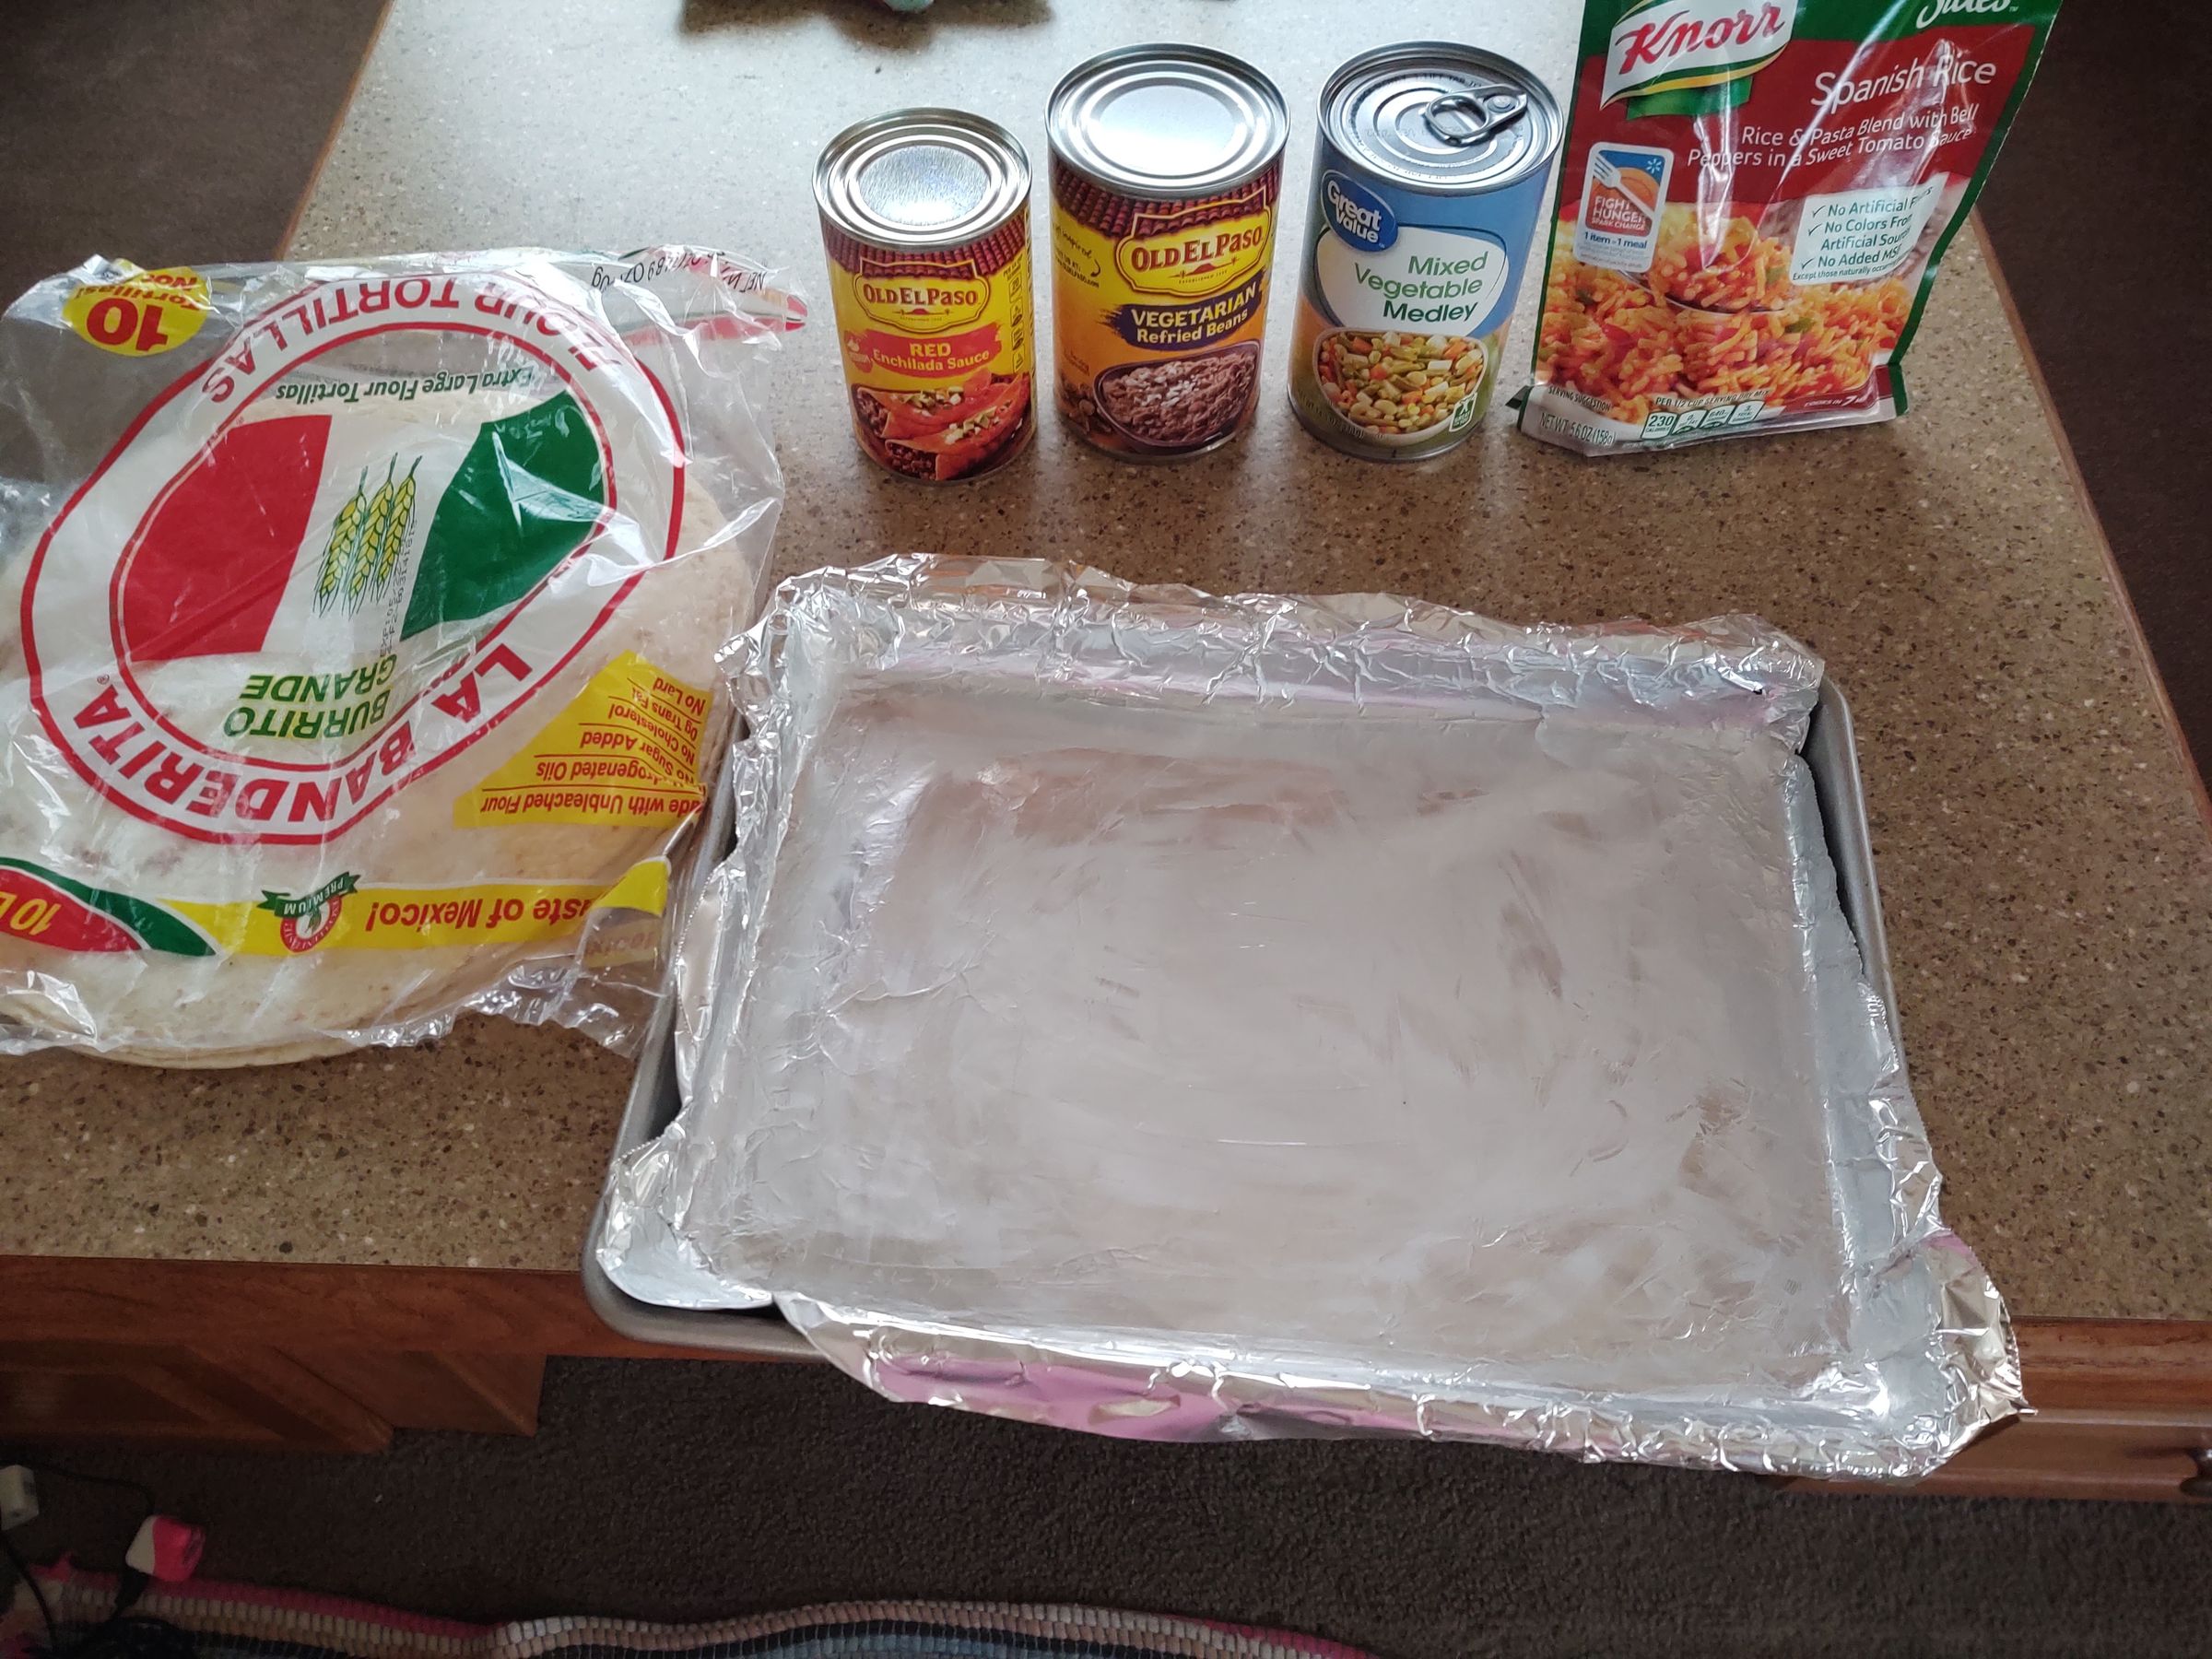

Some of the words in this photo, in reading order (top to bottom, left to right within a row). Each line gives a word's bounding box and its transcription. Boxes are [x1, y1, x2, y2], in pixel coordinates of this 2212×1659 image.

[1615, 2, 1785, 76] Knorr
[1810, 57, 1924, 114] Spanish
[1933, 52, 1996, 88] Rice
[1742, 125, 1783, 147] Rice
[1789, 128, 1807, 147] &
[1809, 124, 1854, 146] Pasta
[1857, 112, 1904, 135] Blend
[1909, 109, 1947, 131] with
[1950, 102, 1980, 125] Bell
[1687, 148, 1762, 171] Peppers
[1768, 147, 1785, 167] in
[1790, 154, 1802, 168] a
[1806, 140, 1853, 166] Sweet
[1857, 133, 1924, 156] Tomato
[1327, 180, 1382, 231] Great
[1594, 195, 1630, 210] FIGHT
[1828, 204, 1846, 217] No
[1849, 198, 1909, 215] Artificial
[1335, 202, 1379, 243] Value
[1825, 221, 1842, 233] No
[1845, 217, 1888, 231] Colors
[1590, 232, 1611, 244] item
[1623, 240, 1648, 249] meal
[1820, 233, 1877, 251] Artificial
[1131, 246, 1181, 273] OLD
[1182, 239, 1215, 264] EL
[1407, 251, 1489, 276] Mixed
[1818, 254, 1836, 267] No
[1839, 250, 1881, 265] Added
[739, 274, 767, 293] NET
[1354, 262, 1483, 300] Vegetable
[1792, 271, 1817, 280] Except
[1818, 268, 1839, 277] those
[1839, 265, 1871, 276] naturally
[863, 284, 899, 304] OLD
[899, 287, 927, 306] EL
[1131, 281, 1257, 328] VEGETARIAN
[1382, 300, 1478, 323] Medley
[86, 298, 169, 352] 10
[1136, 326, 1202, 344] Refried
[1206, 308, 1248, 338] Beans
[201, 277, 460, 403] TORTILLAS
[909, 342, 952, 358] RED
[873, 348, 944, 371] Enchilada
[947, 350, 990, 371] Sauce
[363, 379, 419, 402] Flour
[421, 370, 479, 395] Large
[481, 367, 535, 389] Extra
[276, 381, 360, 406] Tortillas
[1548, 385, 1574, 402] SERVING
[1574, 393, 1612, 413] SUGGESTION
[1655, 396, 1672, 406] PER
[1704, 394, 1737, 406] SERVING
[1841, 395, 1859, 406] 7
[1539, 412, 1555, 429] NET
[1582, 425, 1594, 442] OZ
[1648, 415, 1674, 427] 230
[239, 653, 398, 702] GRANDE
[431, 643, 533, 724] LA
[652, 677, 682, 703] Lard
[223, 688, 391, 740] BURRITO
[652, 701, 682, 732] Trans
[686, 694, 707, 717] No
[579, 730, 638, 751] Added
[607, 703, 679, 753] Cholesterol
[685, 720, 699, 741] 0g
[73, 684, 418, 823] BANDERITA
[641, 741, 674, 779] Sugar
[681, 745, 695, 767] No
[535, 761, 568, 782] Oils
[479, 794, 522, 815] Flour
[524, 792, 624, 815] Unbleached
[628, 796, 665, 816] with
[669, 798, 702, 818] ade
[282, 877, 345, 916] PREMIUM
[9, 898, 62, 936] 10
[364, 898, 483, 933] Mexico!
[487, 898, 524, 930] of
